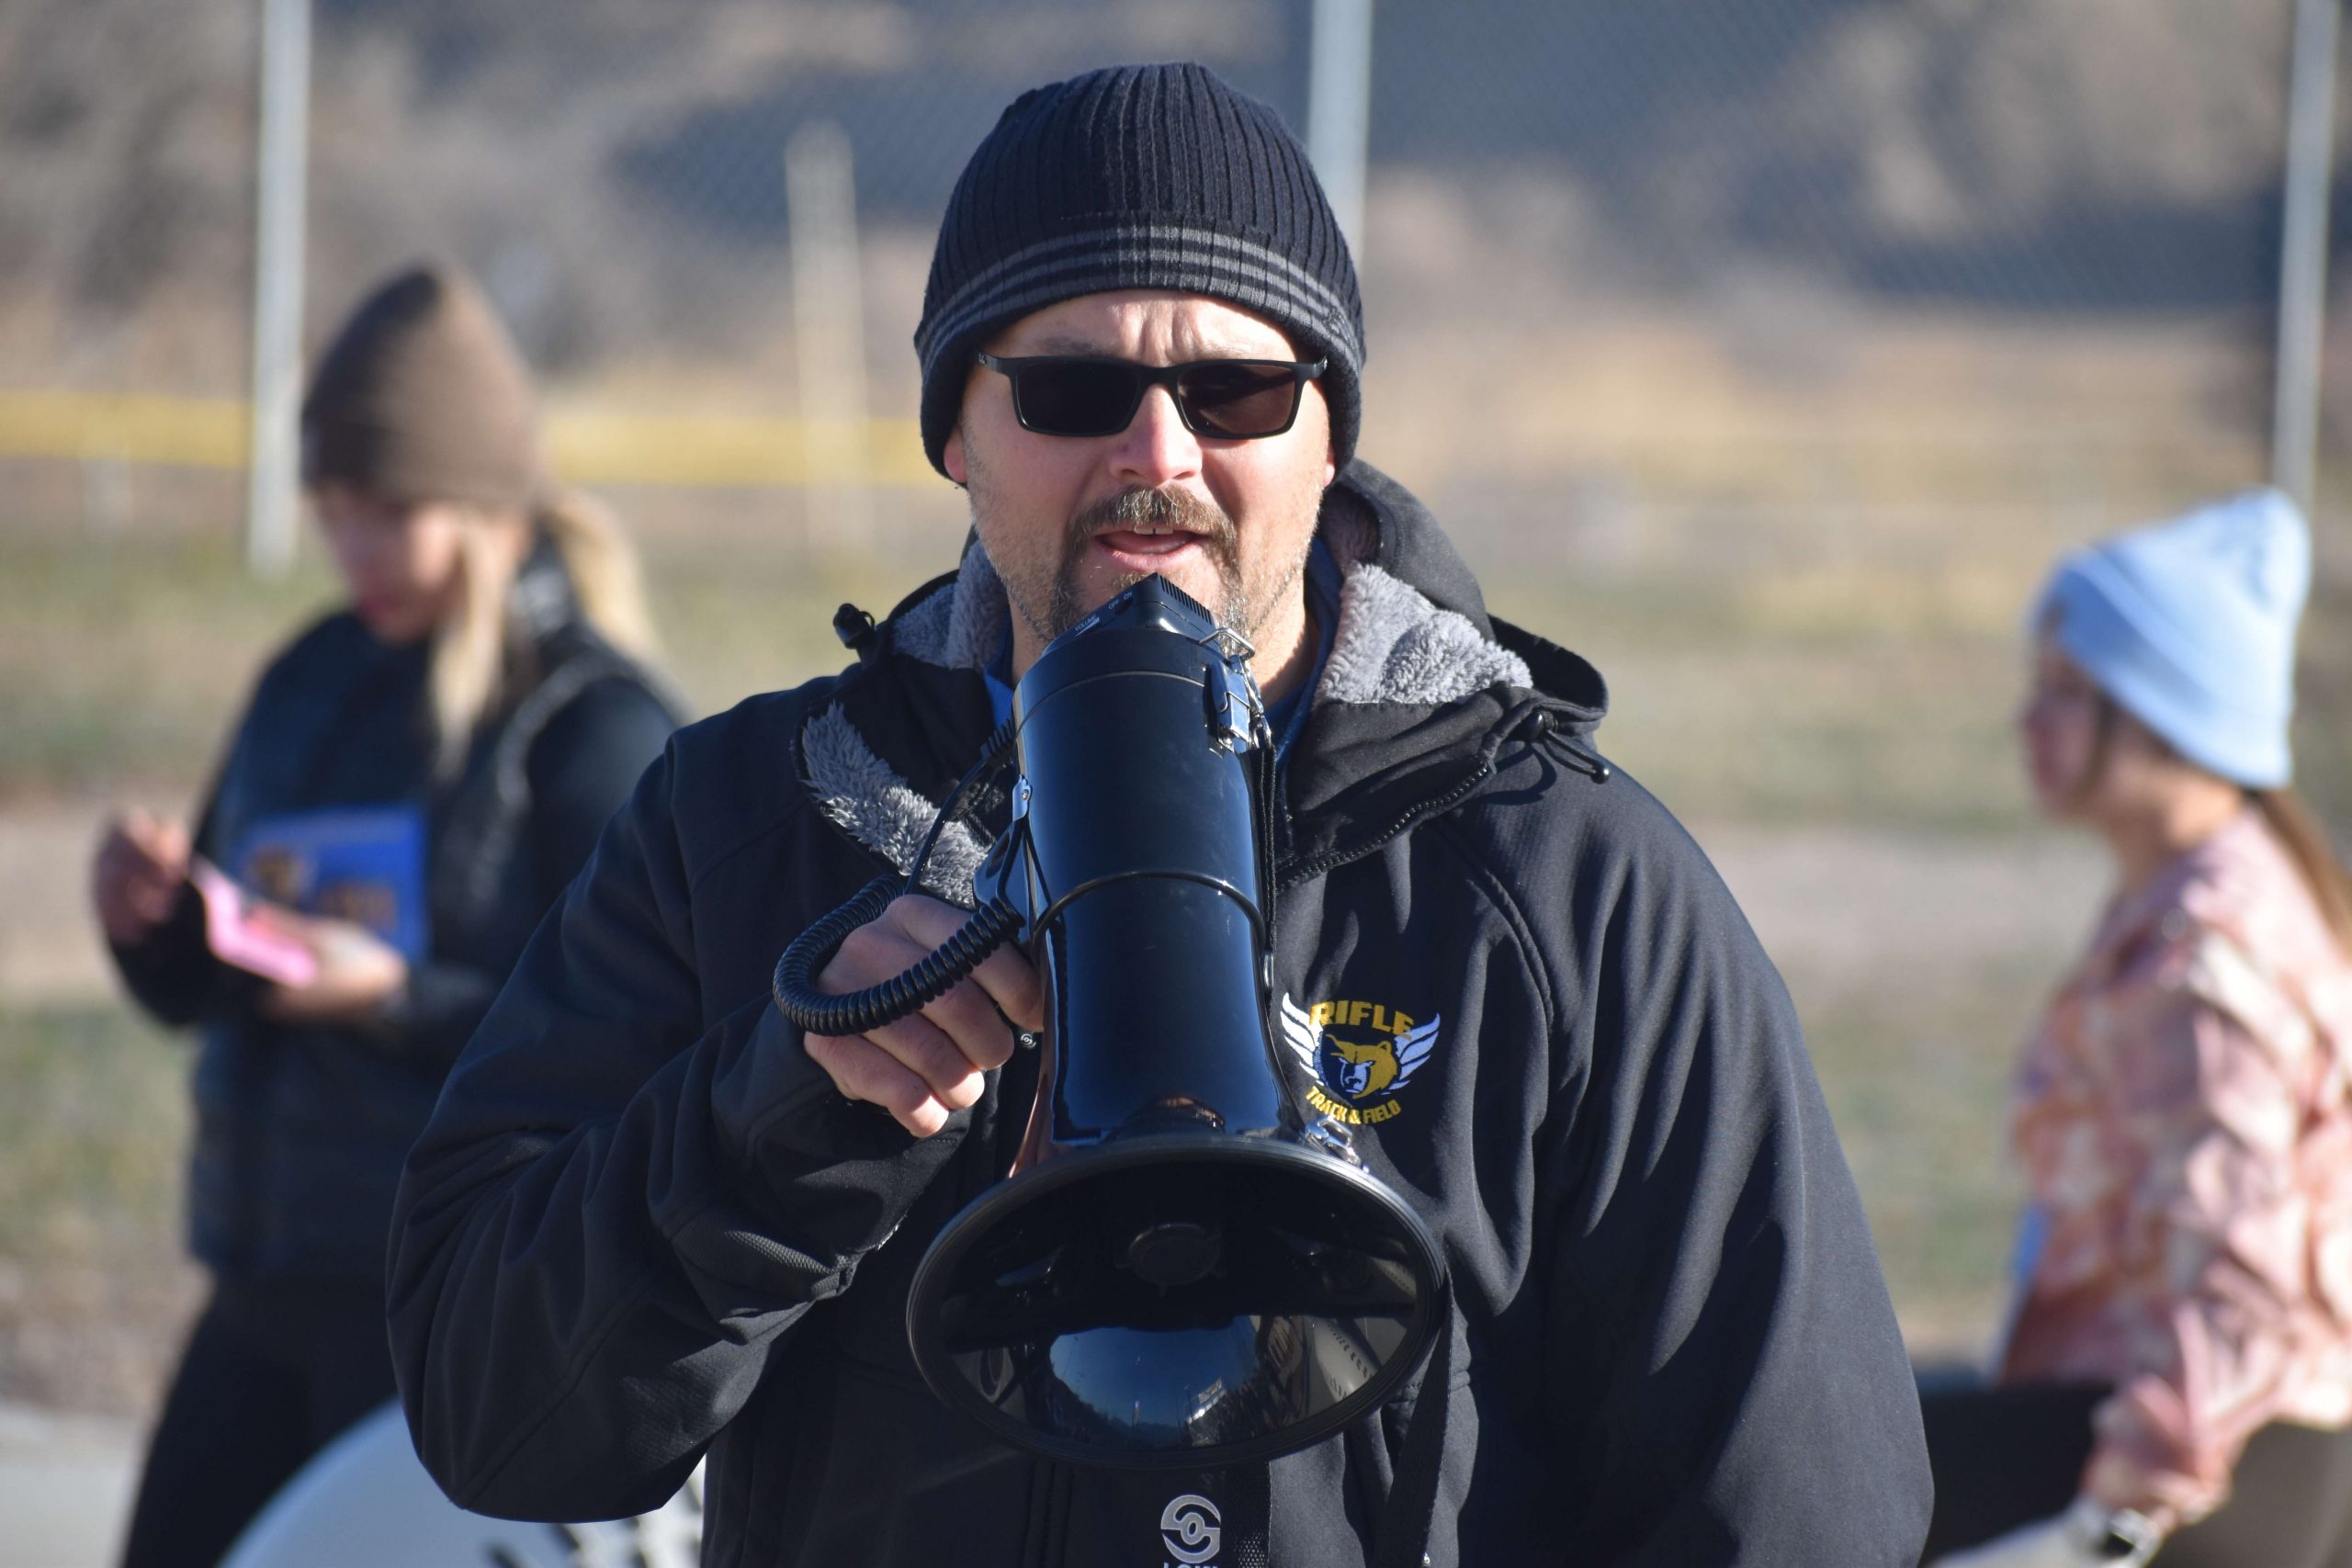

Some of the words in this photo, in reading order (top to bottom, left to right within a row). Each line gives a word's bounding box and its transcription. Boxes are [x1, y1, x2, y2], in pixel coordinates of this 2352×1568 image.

[1108, 599, 1119, 609] OFF
[1123, 591, 1132, 600] ON
[1309, 999, 1414, 1041] RIFLE
[1306, 1086, 1348, 1122] TRACK
[1348, 1109, 1362, 1124] &
[1363, 1100, 1402, 1124] FIELD
